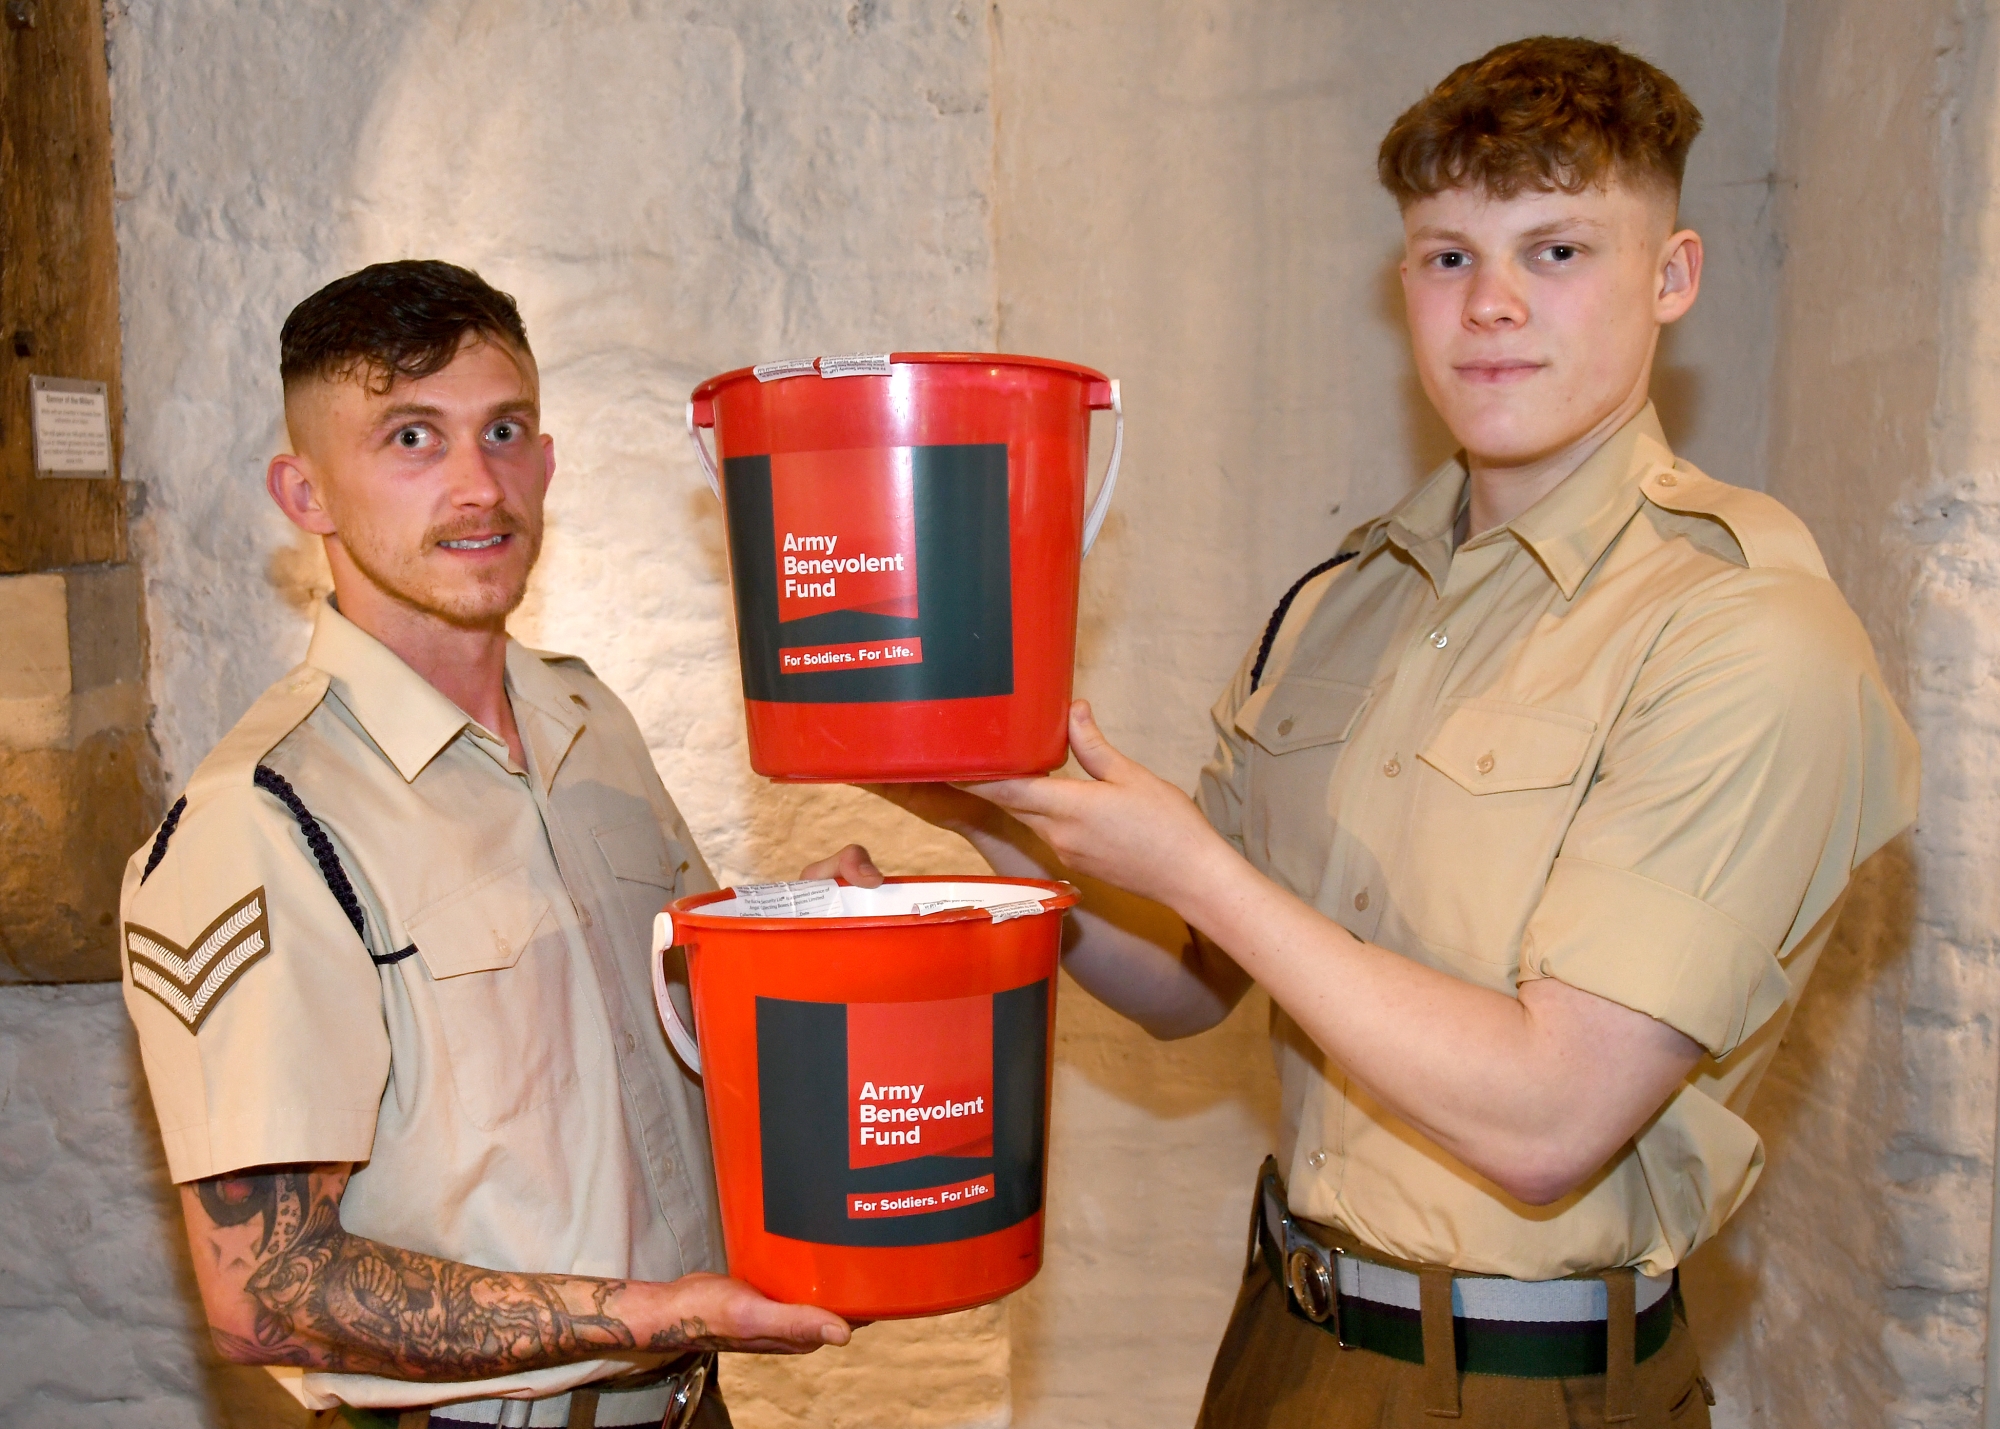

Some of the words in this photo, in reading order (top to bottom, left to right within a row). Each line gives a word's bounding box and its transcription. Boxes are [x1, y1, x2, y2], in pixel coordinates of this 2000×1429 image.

[783, 532, 837, 555] Army
[784, 553, 904, 575] Benevolent
[785, 578, 836, 598] Fund
[784, 655, 801, 666] For
[803, 652, 855, 665] Soldiers.
[858, 649, 881, 661] For
[885, 646, 914, 658] Life.
[859, 1081, 925, 1104] Army
[860, 1096, 984, 1123] Benevolent
[860, 1126, 921, 1146] Fund
[854, 1200, 877, 1211] For
[880, 1196, 938, 1210] Soldiers.
[941, 1190, 962, 1203] For
[965, 1185, 988, 1198] Life.
